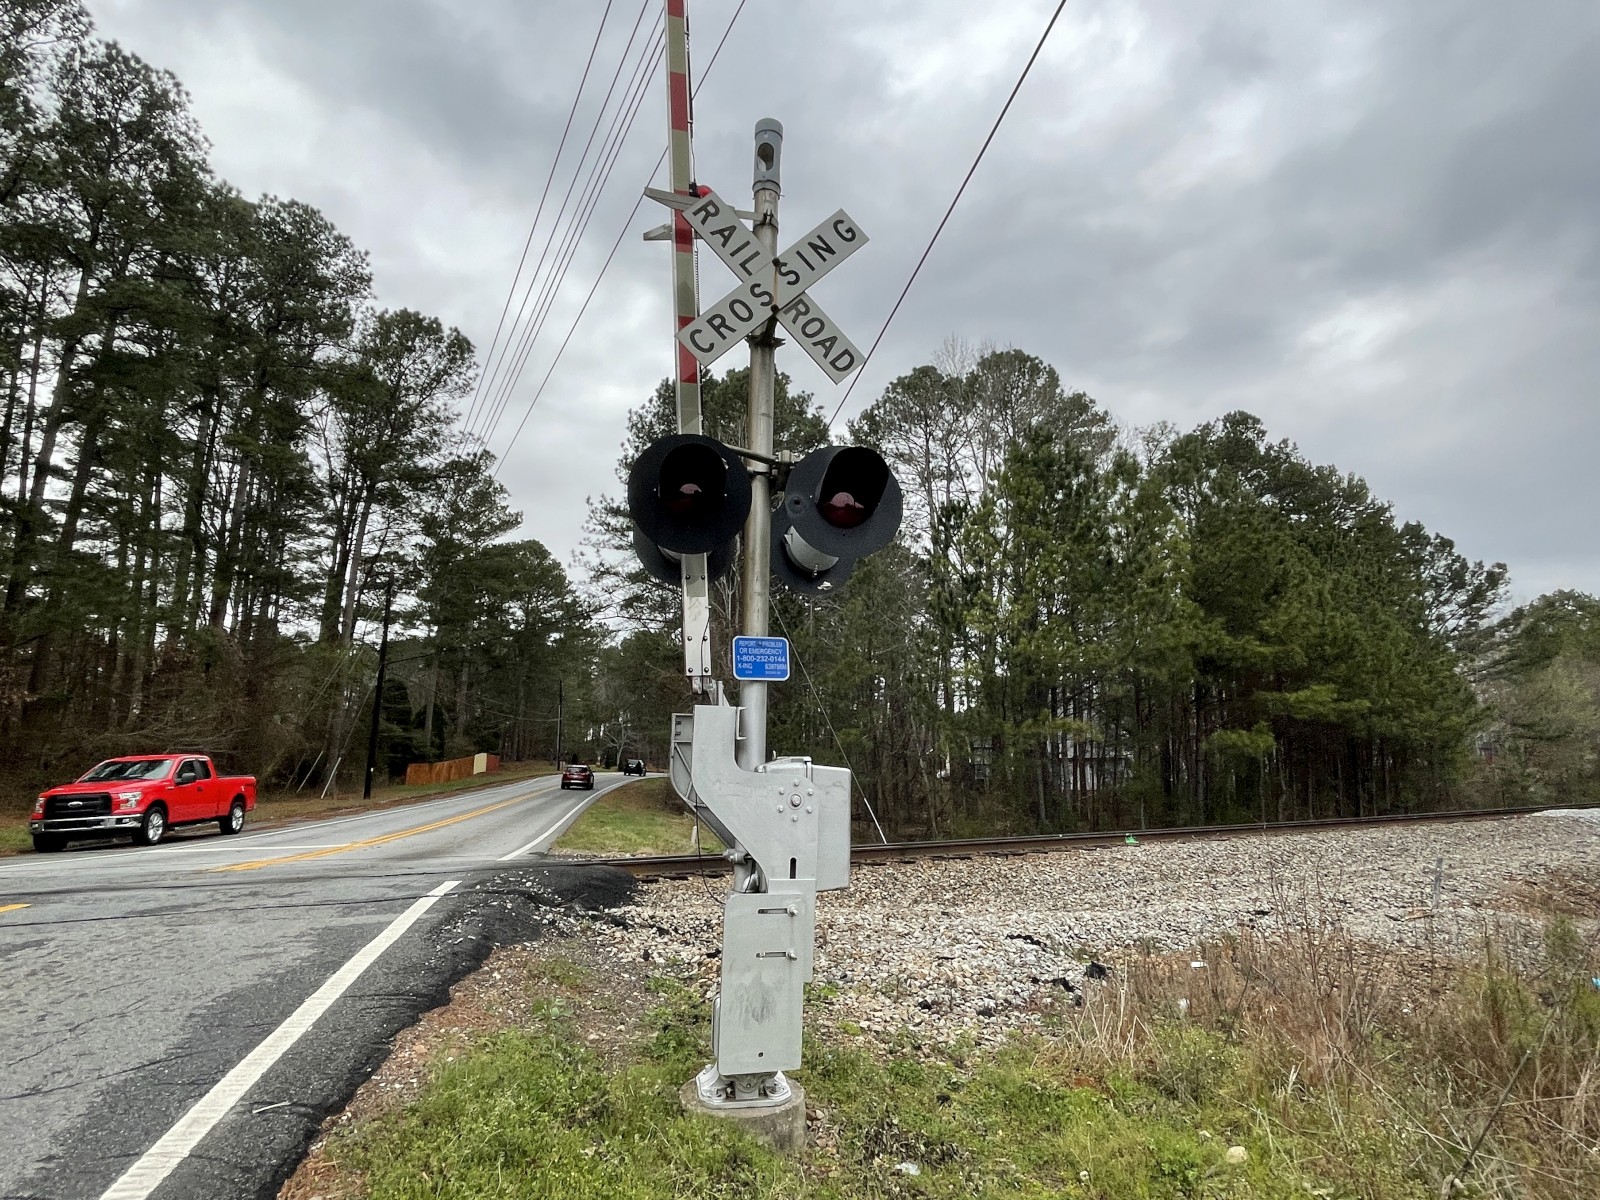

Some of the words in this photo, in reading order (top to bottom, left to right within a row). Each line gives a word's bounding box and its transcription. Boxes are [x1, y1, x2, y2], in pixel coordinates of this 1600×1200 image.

[689, 219, 857, 353] CROSSING
[692, 199, 760, 277] RAIL
[782, 297, 855, 373] ROAD
